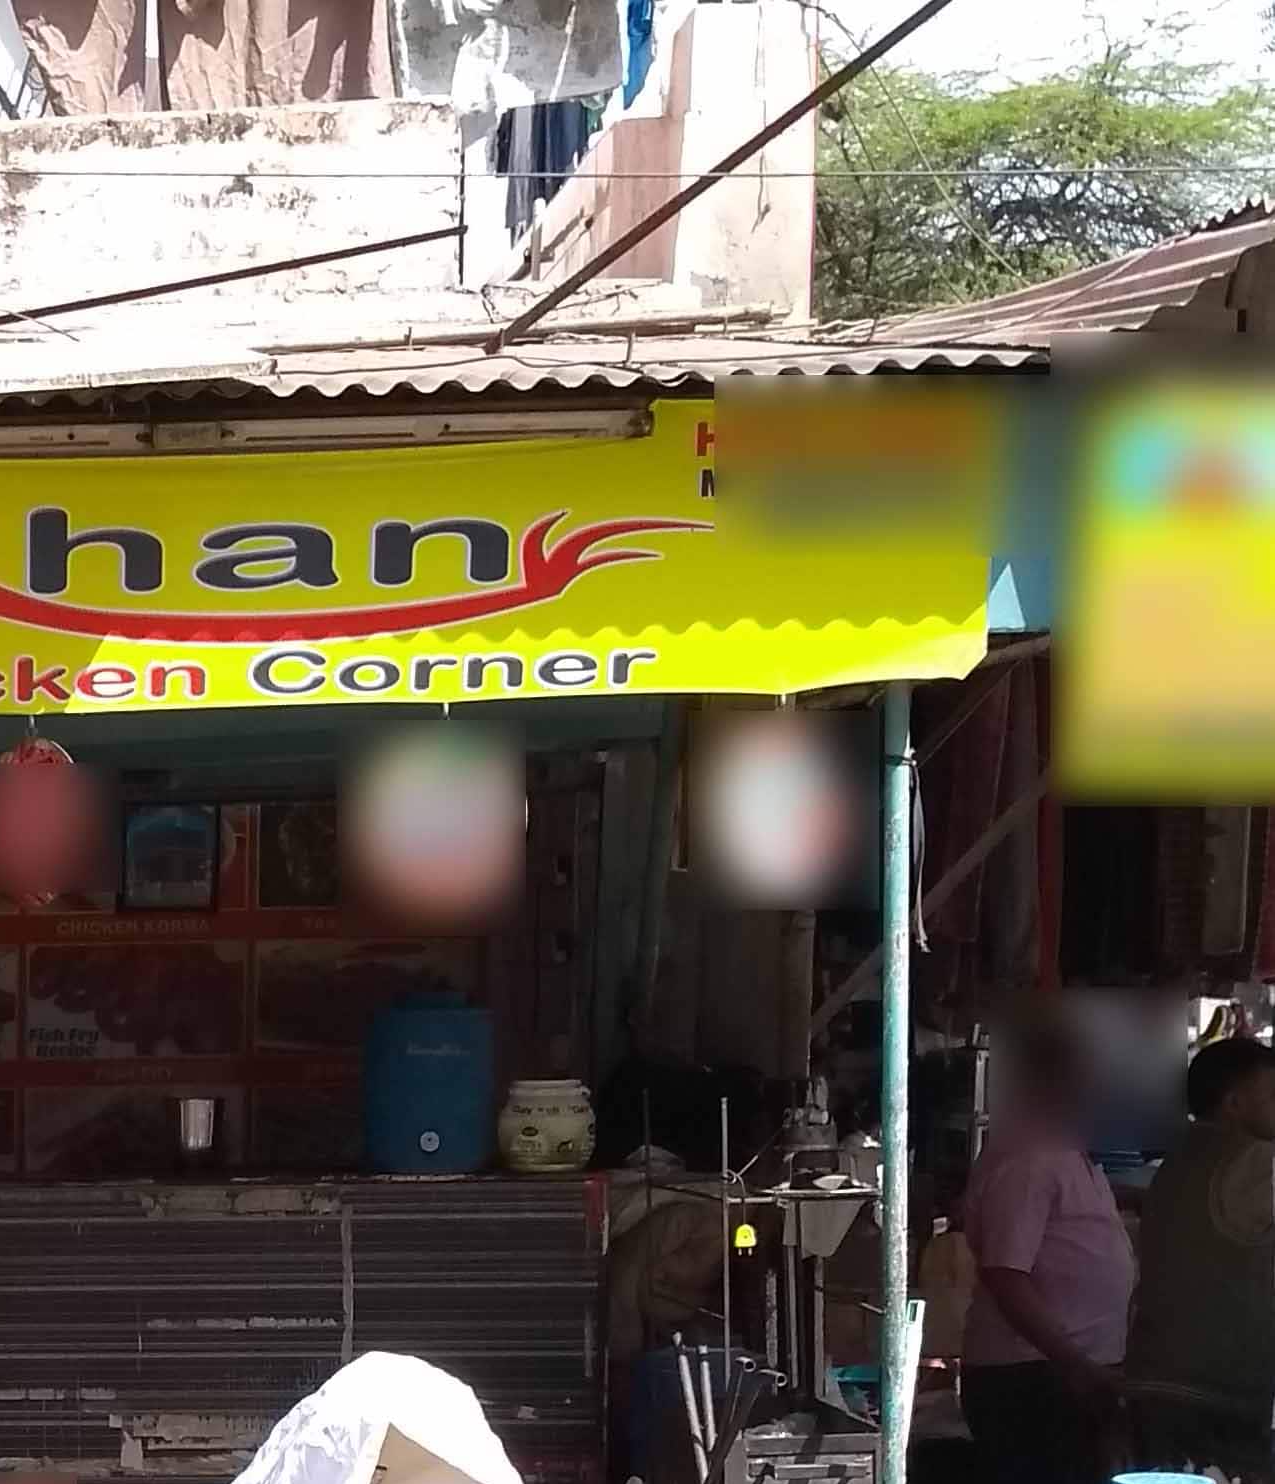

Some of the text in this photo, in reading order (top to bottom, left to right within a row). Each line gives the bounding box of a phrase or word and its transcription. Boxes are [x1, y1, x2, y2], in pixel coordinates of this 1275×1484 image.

[249, 646, 659, 695] Corner
[56, 920, 139, 936] CHICKEN
[29, 1028, 100, 1046] Fish Fry
